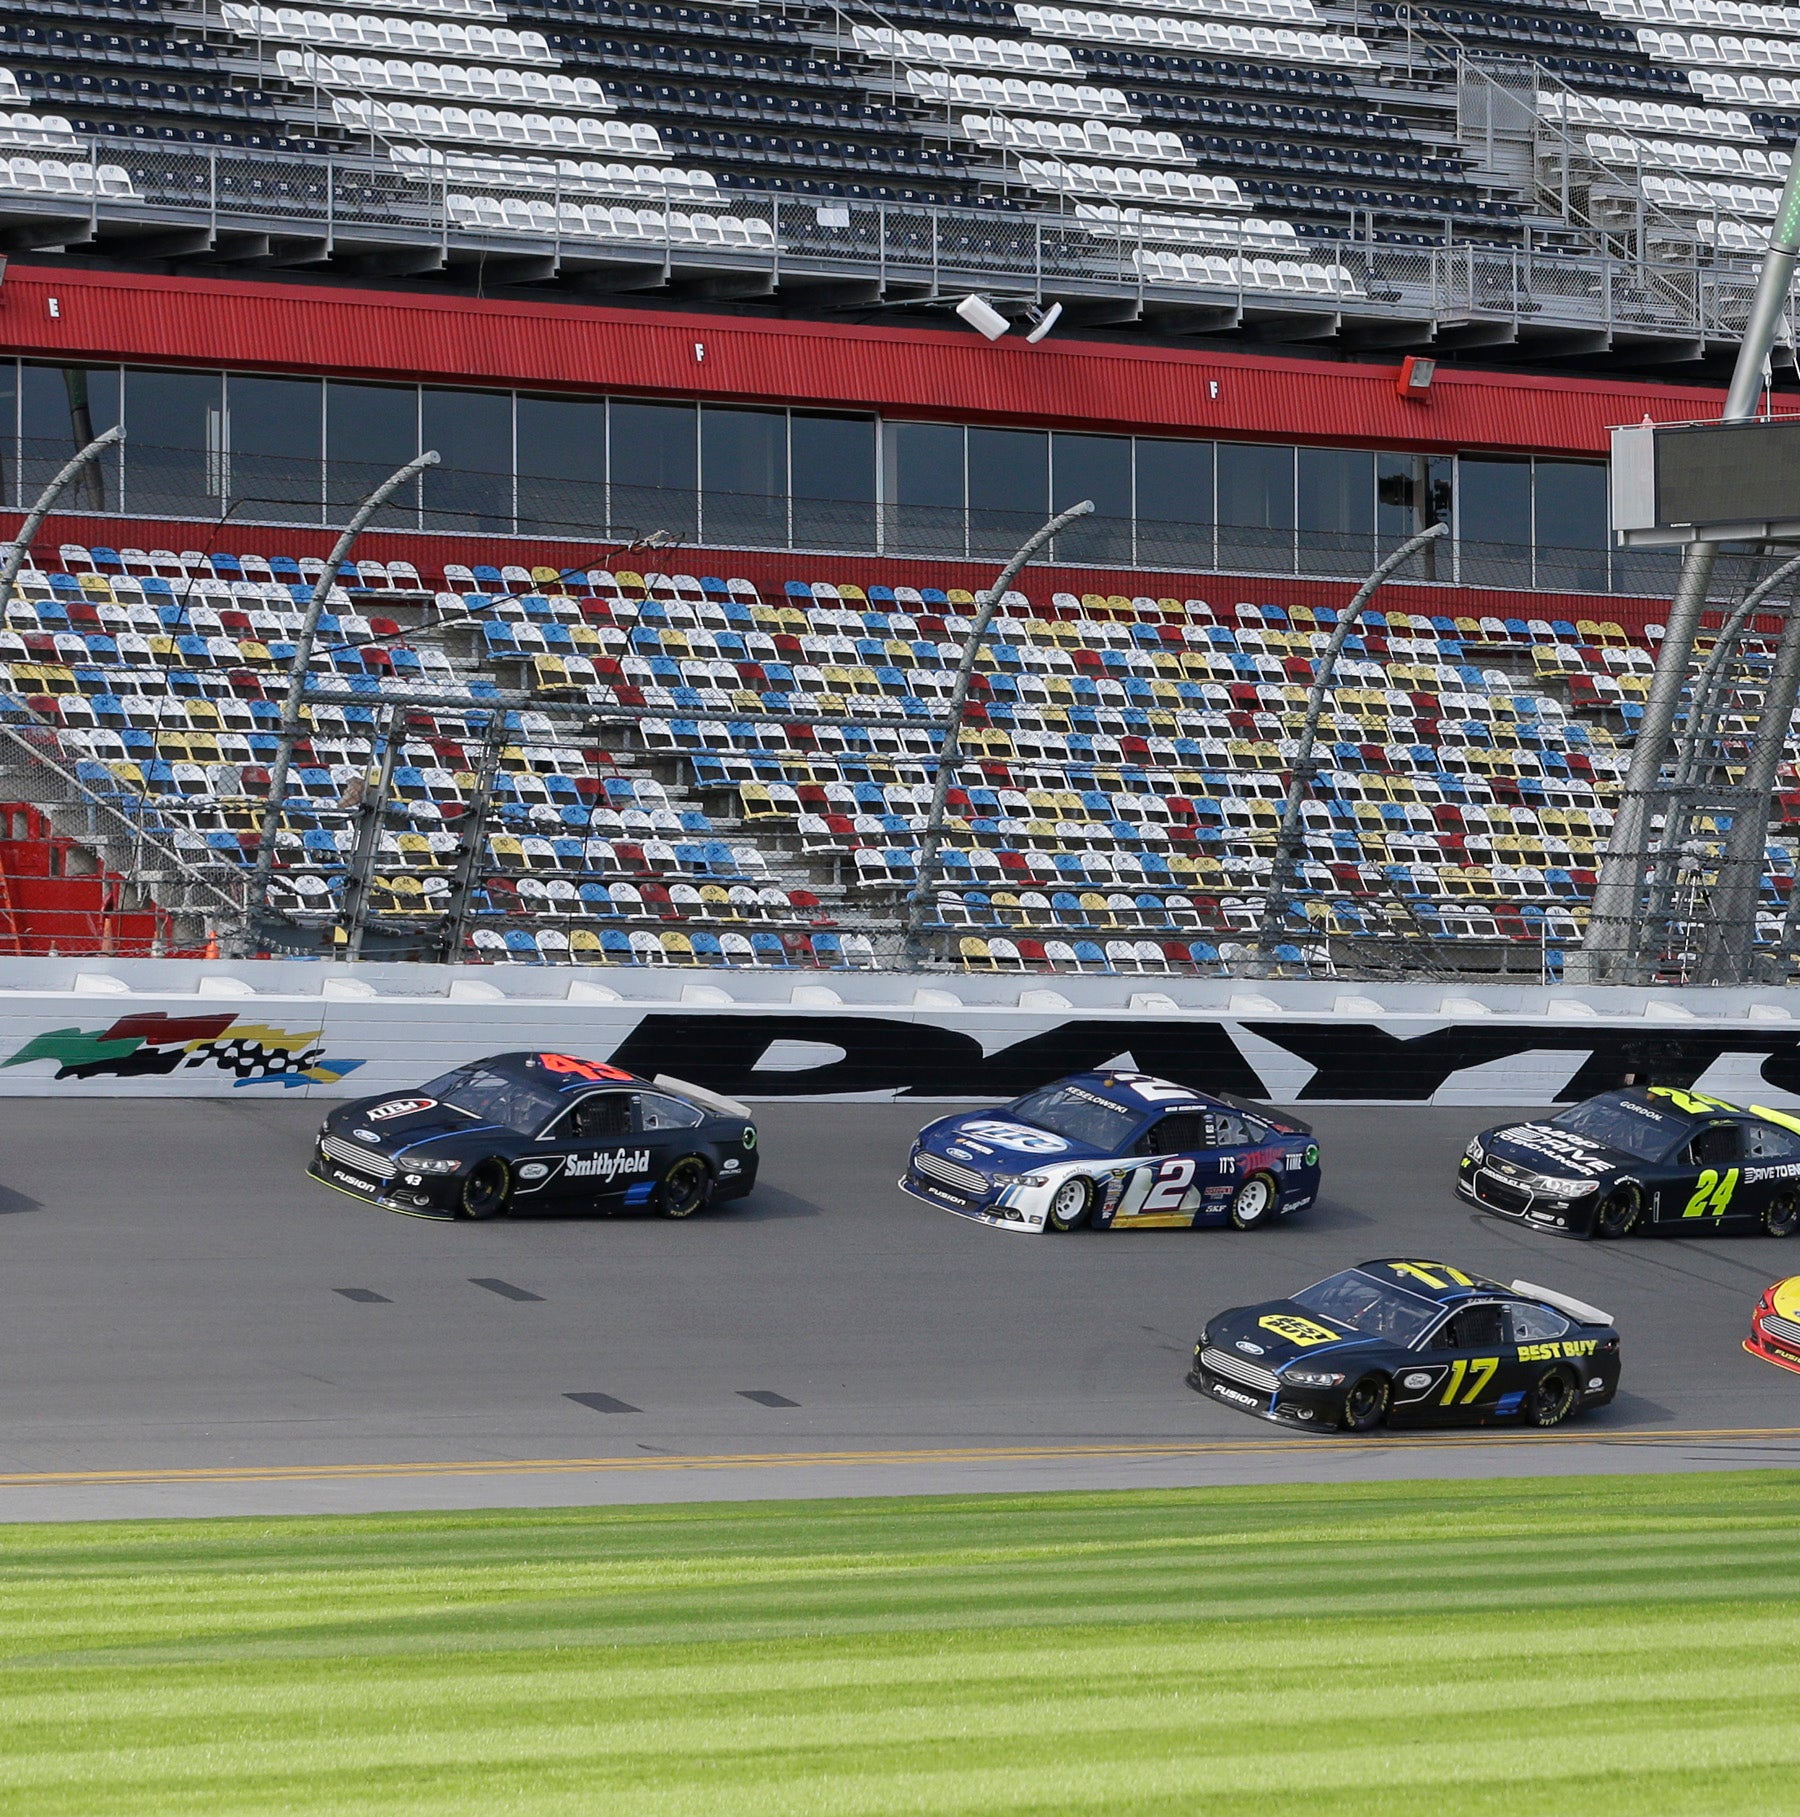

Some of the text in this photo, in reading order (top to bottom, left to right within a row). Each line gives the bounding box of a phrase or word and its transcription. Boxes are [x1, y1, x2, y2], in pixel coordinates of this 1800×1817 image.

[49, 298, 59, 317] E
[695, 344, 703, 361] F
[1210, 382, 1217, 398] F
[539, 1054, 634, 1081] 43
[1114, 1073, 1198, 1101] 2
[1065, 1086, 1128, 1114] KESELOWSKI
[1648, 1086, 1740, 1114] 24
[564, 1148, 649, 1183] Smithfield
[1219, 1156, 1235, 1174] IT'S
[1286, 1153, 1303, 1171] TIME
[333, 1170, 376, 1193] FUSION
[404, 1174, 423, 1186] 43
[1141, 1159, 1196, 1211] 2
[928, 1187, 967, 1206] FUSION
[1682, 1168, 1739, 1217] 24
[1206, 1205, 1227, 1213] SKF
[1388, 1262, 1474, 1290] 17
[1276, 1317, 1332, 1341] BEST
[1517, 1340, 1598, 1363] BEST BUY
[1439, 1357, 1499, 1406] 17
[1212, 1384, 1258, 1407] FUSION
